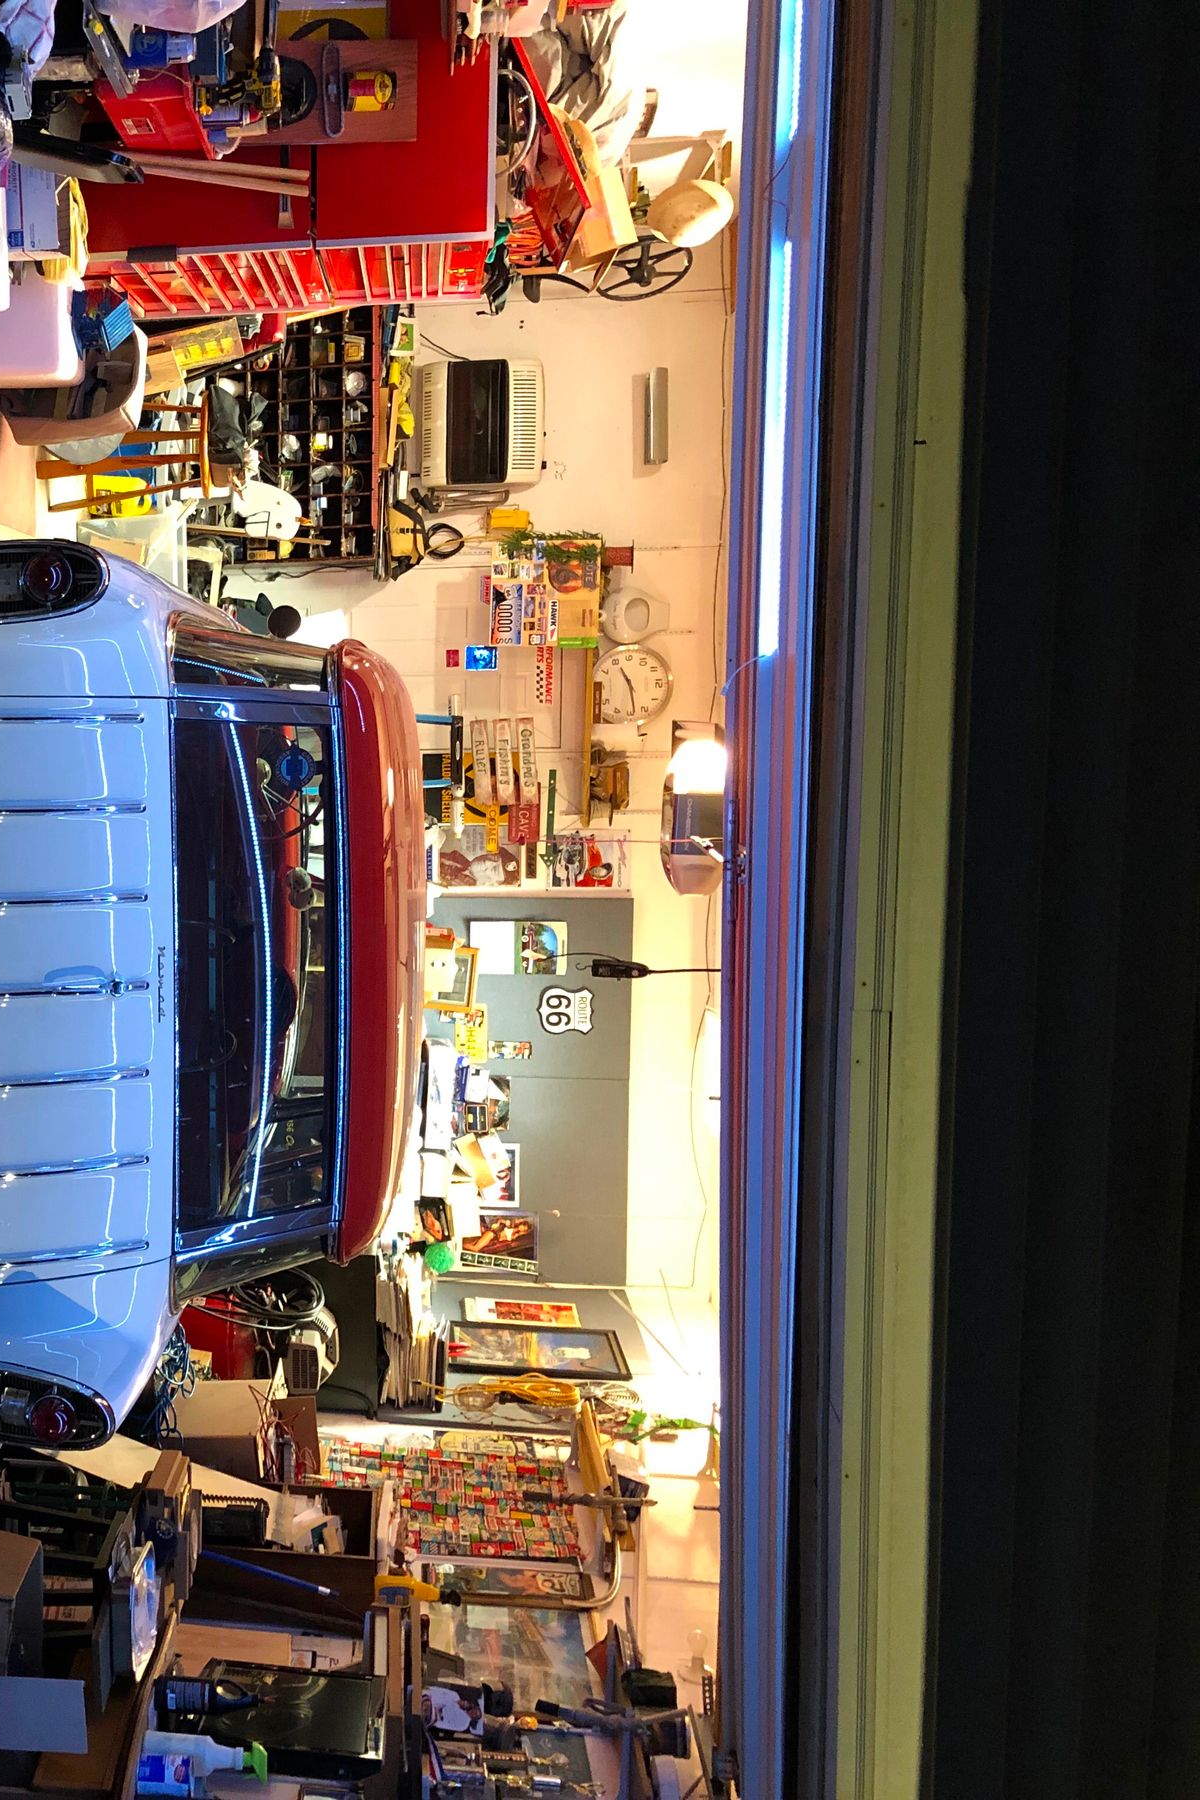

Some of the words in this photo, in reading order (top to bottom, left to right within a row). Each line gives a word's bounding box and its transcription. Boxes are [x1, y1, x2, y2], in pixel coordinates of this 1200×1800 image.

[497, 604, 513, 632] 0000
[550, 601, 558, 626] HAWK
[536, 646, 544, 664] RTS
[639, 657, 647, 667] 10
[544, 646, 554, 705] RFORMANCE
[655, 678, 663, 689] 12
[442, 754, 451, 780] FALLO
[442, 790, 452, 822] SHELTER
[488, 809, 497, 845] COME
[518, 810, 530, 838] CAVE
[546, 994, 572, 1026] 66
[578, 996, 588, 1025] ROUTE
